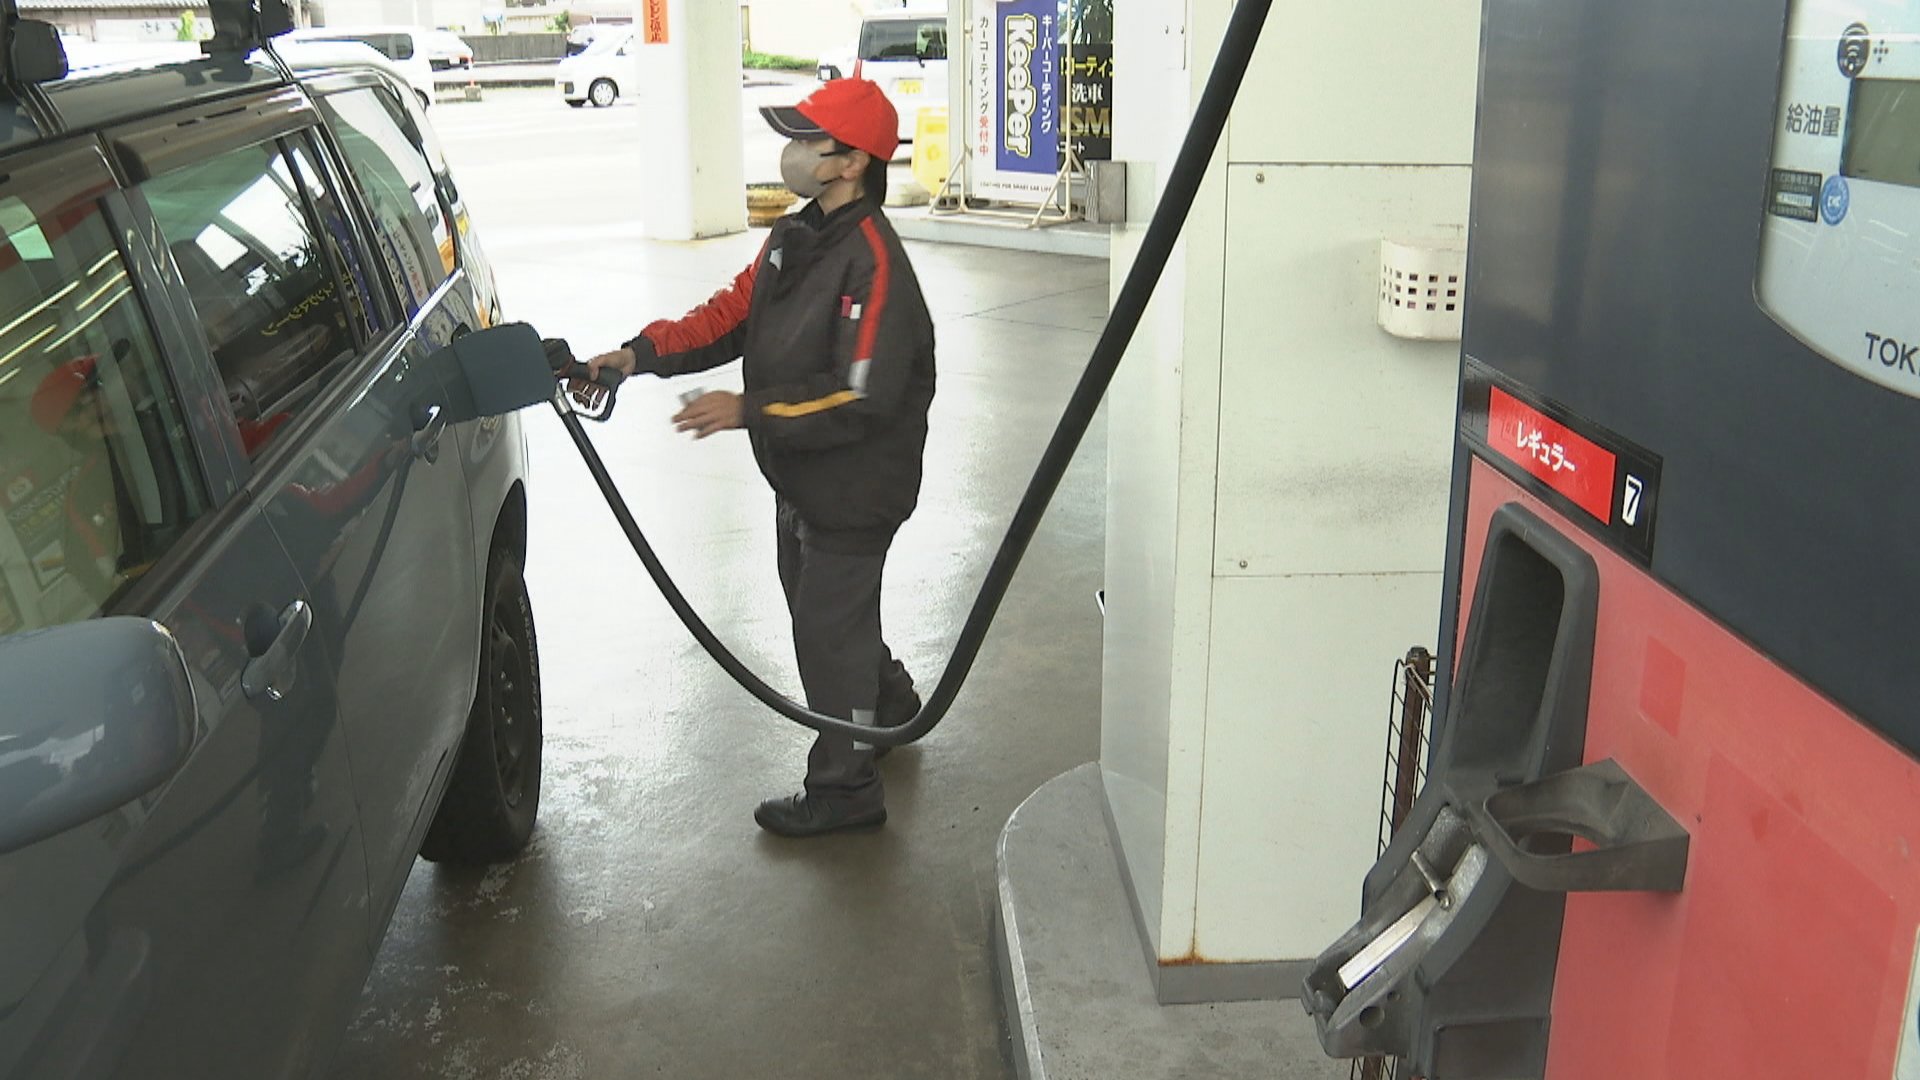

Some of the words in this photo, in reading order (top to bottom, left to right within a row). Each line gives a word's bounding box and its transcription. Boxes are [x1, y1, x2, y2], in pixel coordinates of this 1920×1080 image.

[979, 16, 989, 157] カーコーティング受付中
[1005, 13, 1037, 156] KeePer
[1041, 14, 1053, 133] キーパーコーティング
[1071, 83, 1104, 104] 洗車
[1056, 106, 1110, 138] ISM
[1785, 103, 1841, 137] 給油量
[1865, 331, 1920, 377] TOK
[1516, 421, 1576, 472] レギュラー
[1622, 474, 1643, 525] 7
